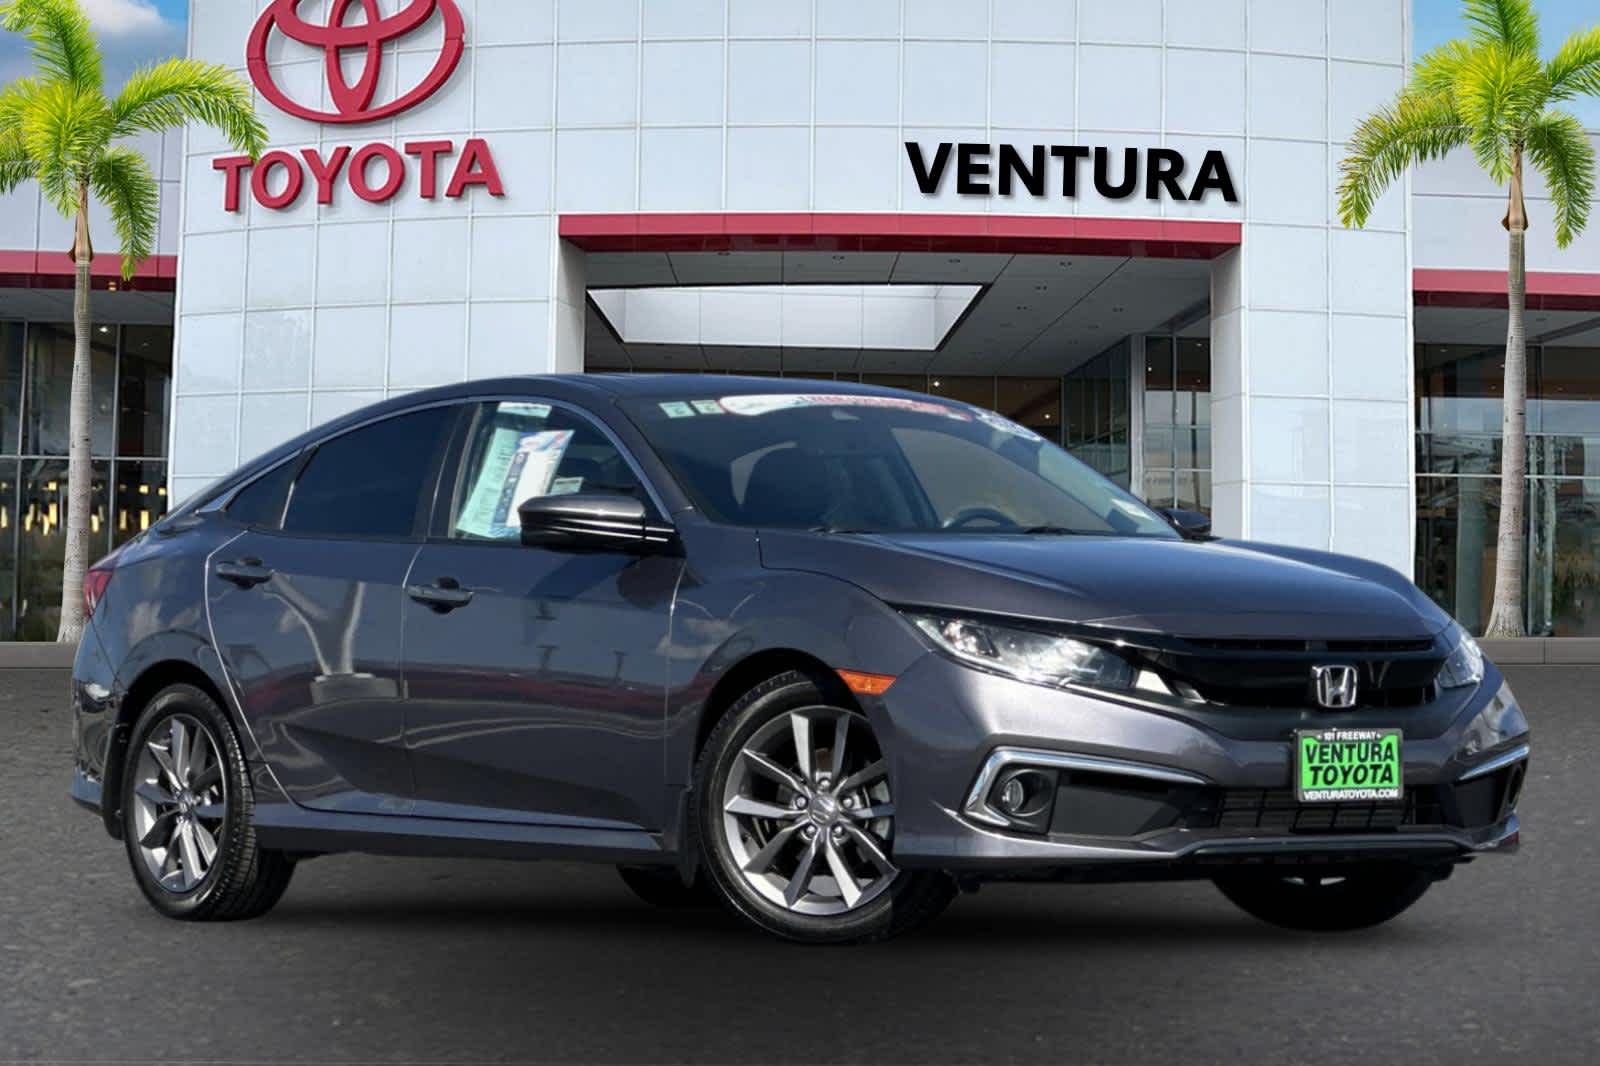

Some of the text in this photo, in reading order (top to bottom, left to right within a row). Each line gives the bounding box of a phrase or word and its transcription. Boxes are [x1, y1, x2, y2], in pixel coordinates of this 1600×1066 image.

[212, 138, 505, 212] TOYOTA
[904, 142, 1239, 204] VENTURA
[1337, 731, 1377, 741] FREEWAY
[1305, 742, 1395, 764] VENTURA
[1309, 764, 1393, 786] TOYOTA
[1303, 789, 1399, 800] VENTURATOYOTA.COM
